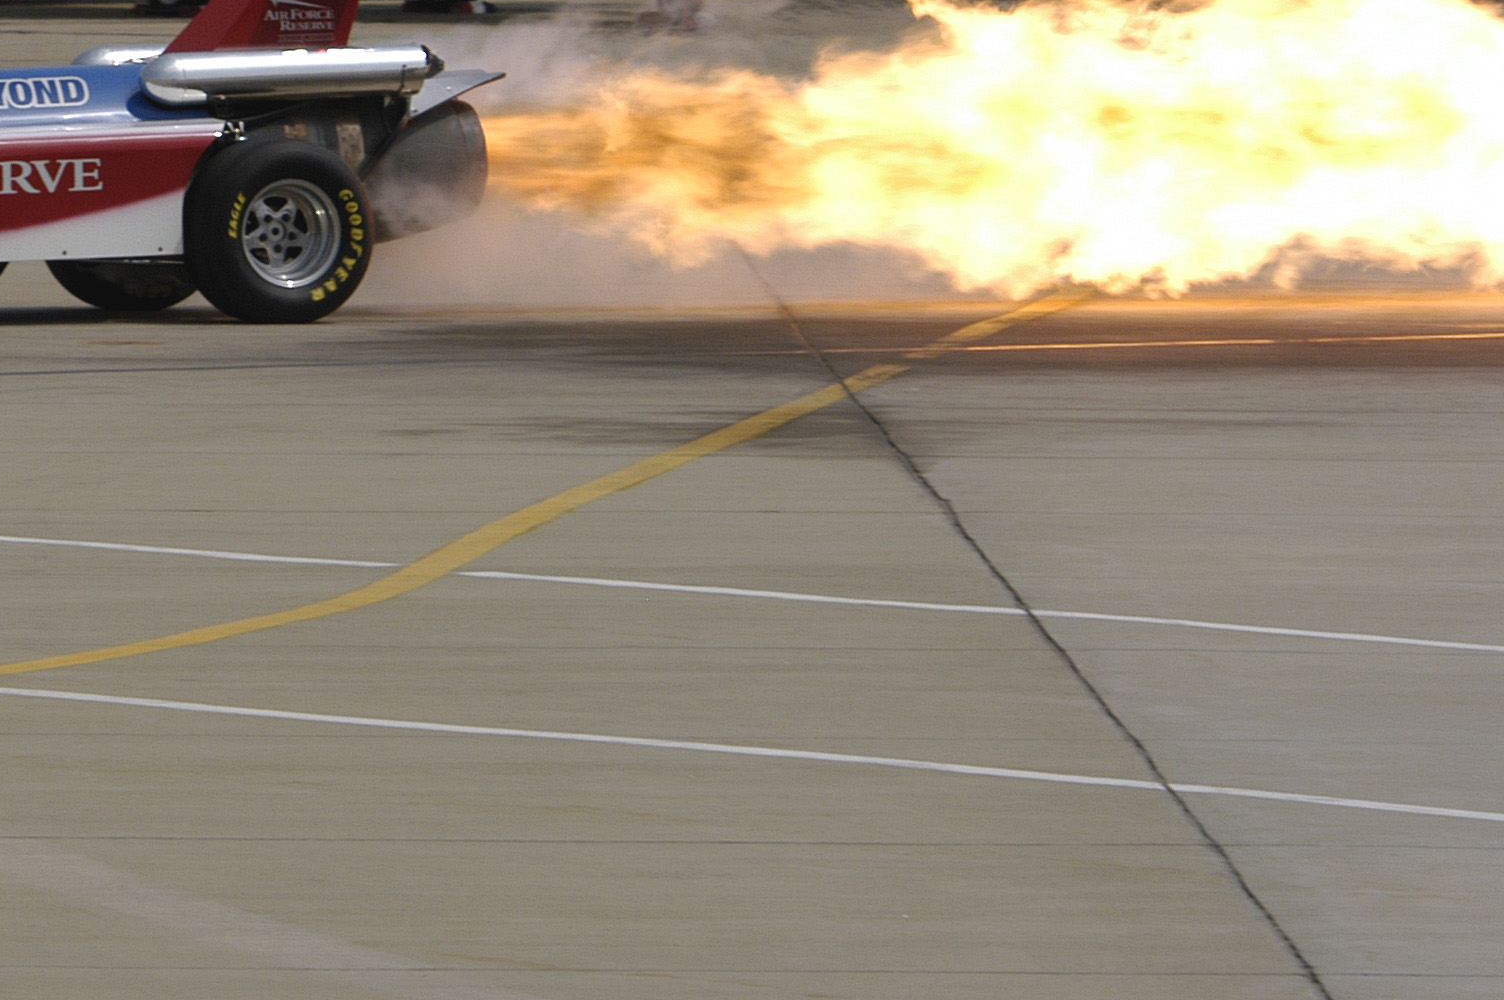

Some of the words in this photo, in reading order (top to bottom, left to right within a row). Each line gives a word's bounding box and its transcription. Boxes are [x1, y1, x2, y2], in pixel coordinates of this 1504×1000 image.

[264, 9, 289, 20] AIR
[290, 8, 335, 20] FORCE
[280, 20, 335, 32] RESERVE
[227, 191, 247, 240] EAGLE
[310, 188, 364, 302] GOODYEAR
